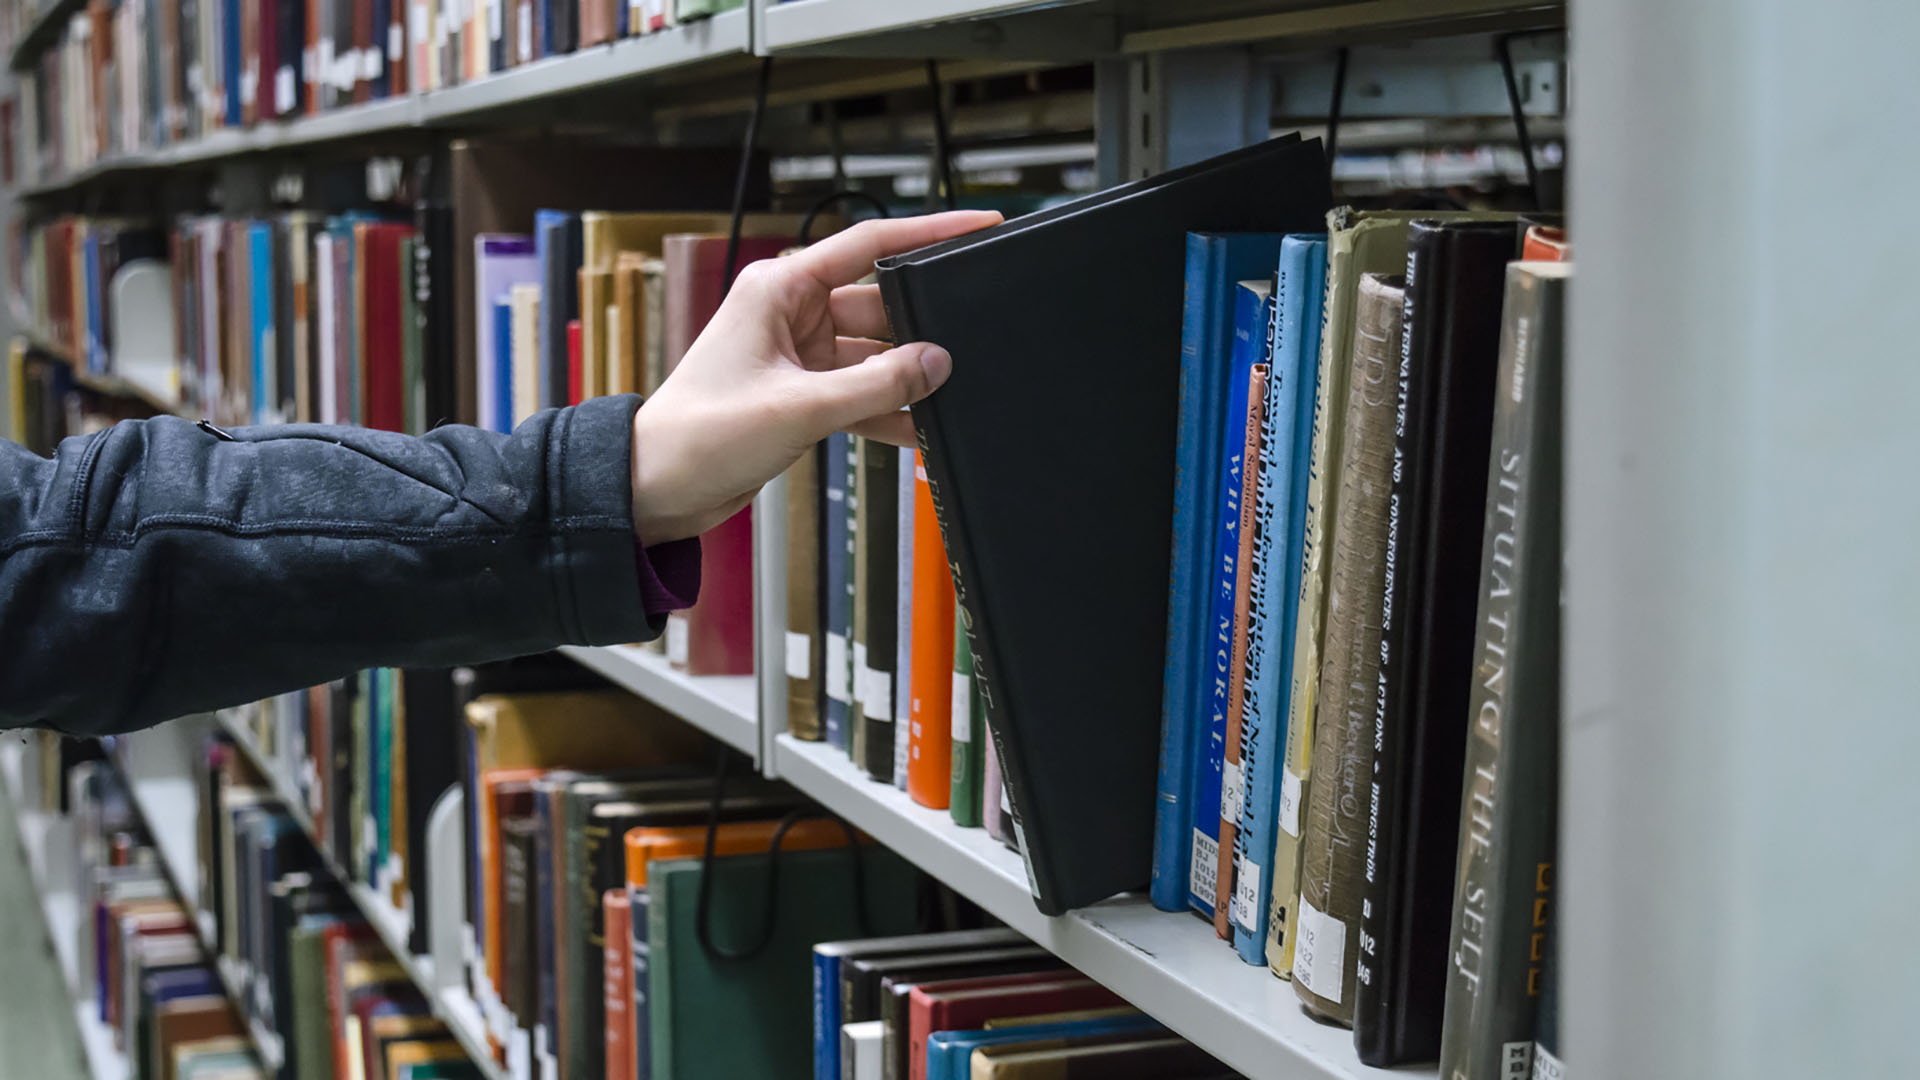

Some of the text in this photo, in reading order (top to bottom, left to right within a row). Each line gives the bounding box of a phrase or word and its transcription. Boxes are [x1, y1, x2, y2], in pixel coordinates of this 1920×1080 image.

[1406, 251, 1416, 287] THE
[1396, 295, 1414, 437] ALTERNATIVES
[1248, 405, 1257, 447] Moral
[1266, 370, 1284, 468] Toward
[1265, 475, 1274, 488] a
[1392, 447, 1403, 483] AND
[1254, 501, 1274, 681] Reformulation
[1300, 503, 1315, 602] Ethics
[1382, 494, 1400, 630] CONSEQUENCES
[1210, 454, 1241, 771] WHY BE MORAL?
[1381, 640, 1390, 664] OF
[1251, 690, 1261, 722] of
[1374, 671, 1388, 752] ACTIONS
[1457, 449, 1520, 997] SITUATING THE SELF
[1244, 724, 1260, 820] Natural
[1242, 824, 1253, 858] La
